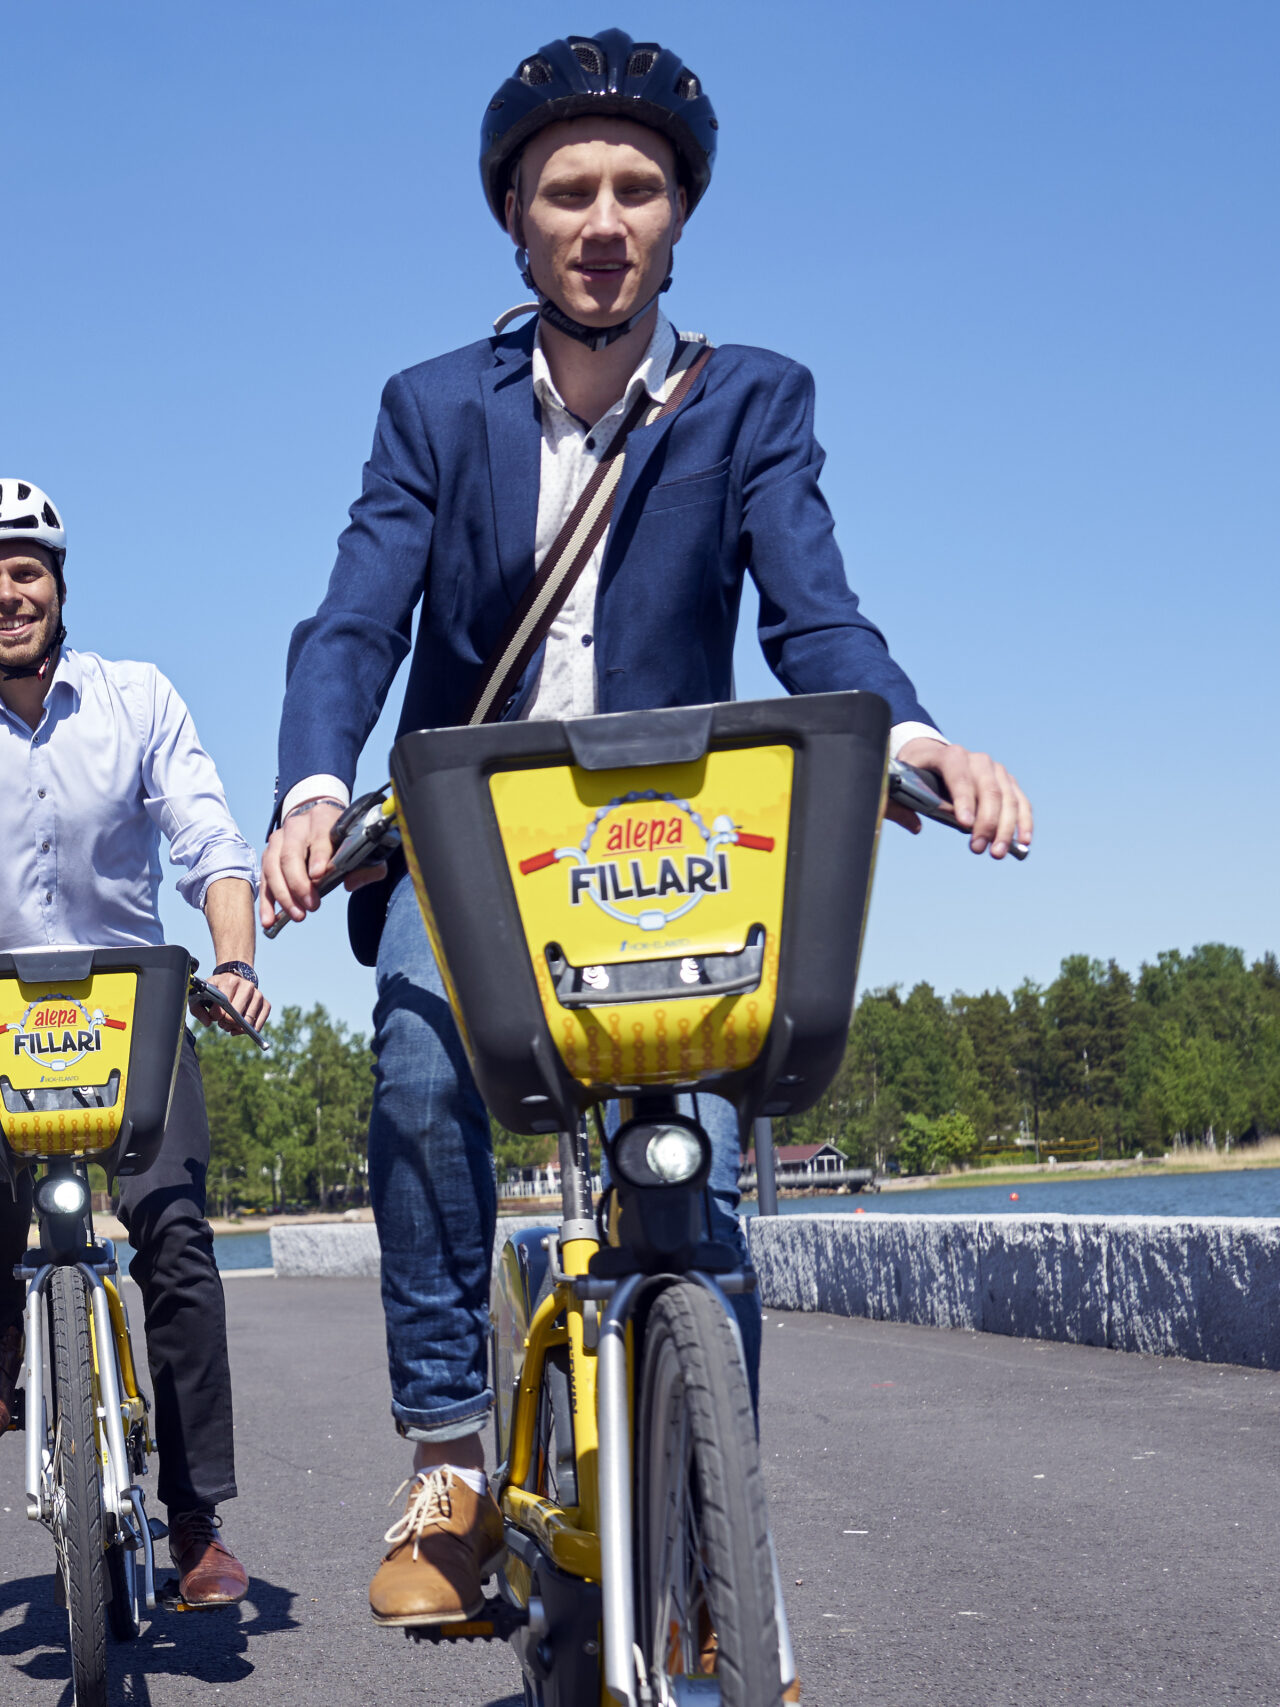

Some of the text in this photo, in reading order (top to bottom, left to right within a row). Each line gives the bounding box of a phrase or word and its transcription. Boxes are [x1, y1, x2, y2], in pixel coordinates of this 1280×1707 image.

[607, 817, 683, 851] alepa
[570, 853, 730, 906] FILLARI
[33, 1008, 78, 1028] alepa
[13, 1029, 102, 1057] FILLARI
